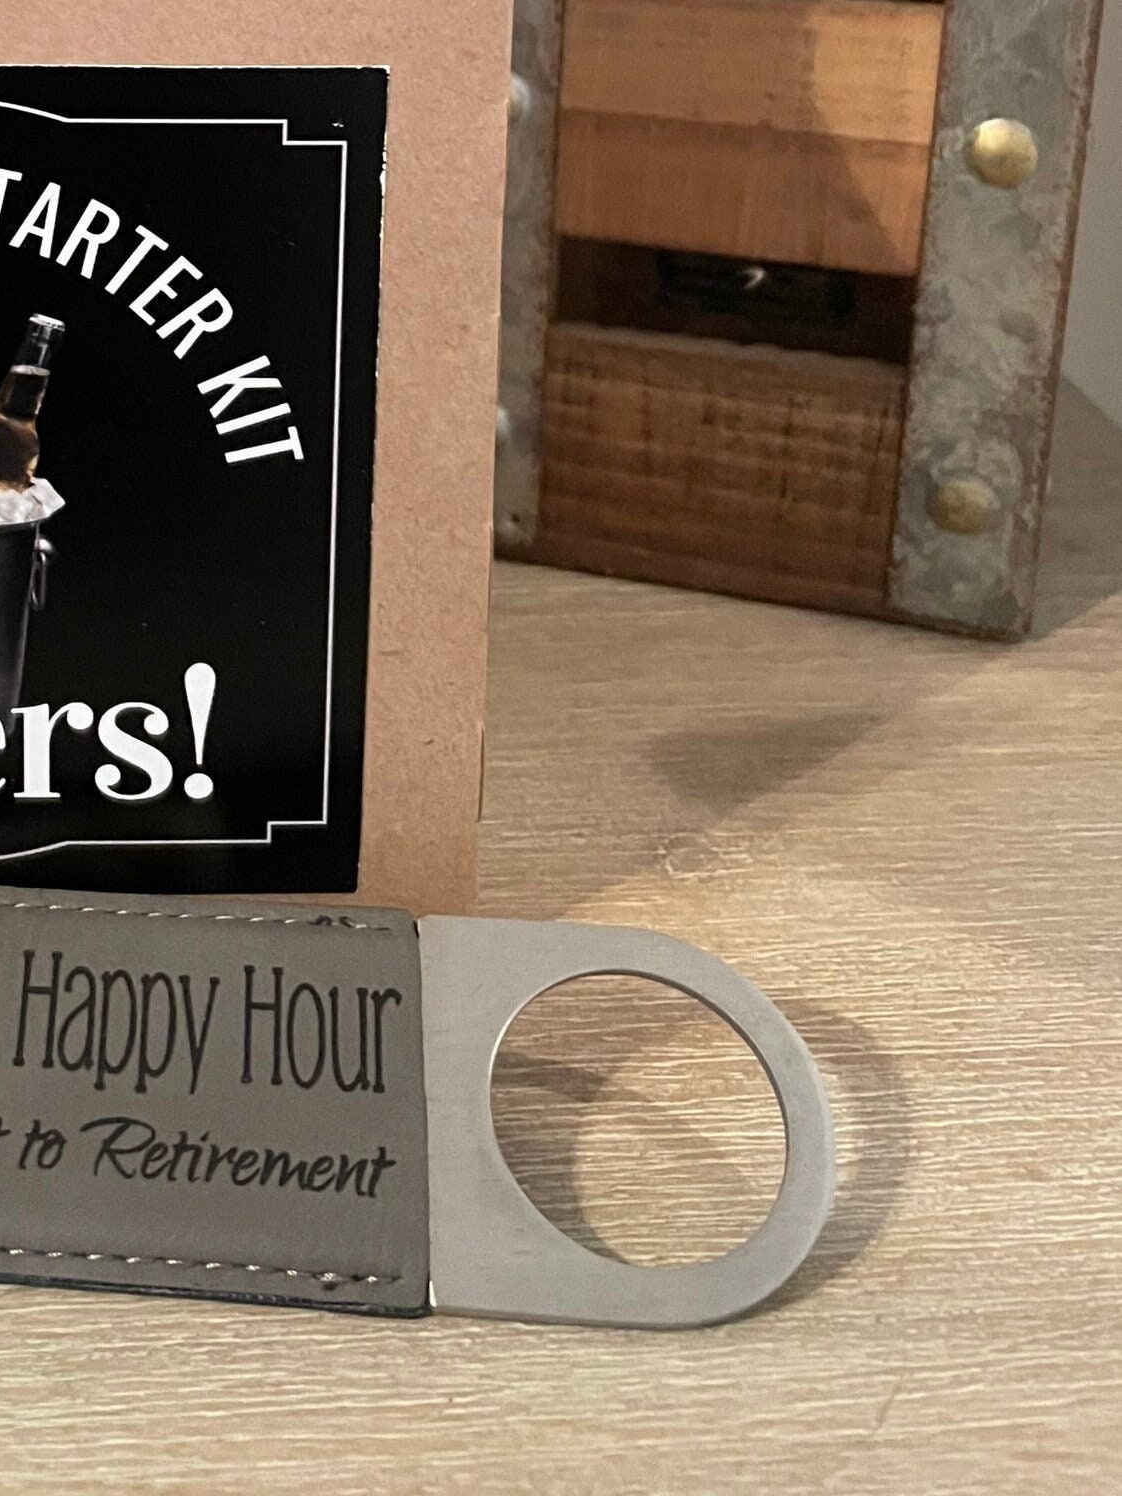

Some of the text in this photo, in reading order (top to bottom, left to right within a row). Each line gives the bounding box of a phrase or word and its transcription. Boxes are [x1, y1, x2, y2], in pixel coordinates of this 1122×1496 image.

[197, 355, 305, 465] KIT
[12, 949, 221, 1096] Happy
[240, 964, 403, 1095] Hour
[18, 1119, 68, 1171] to
[79, 1116, 399, 1199] Retirement
